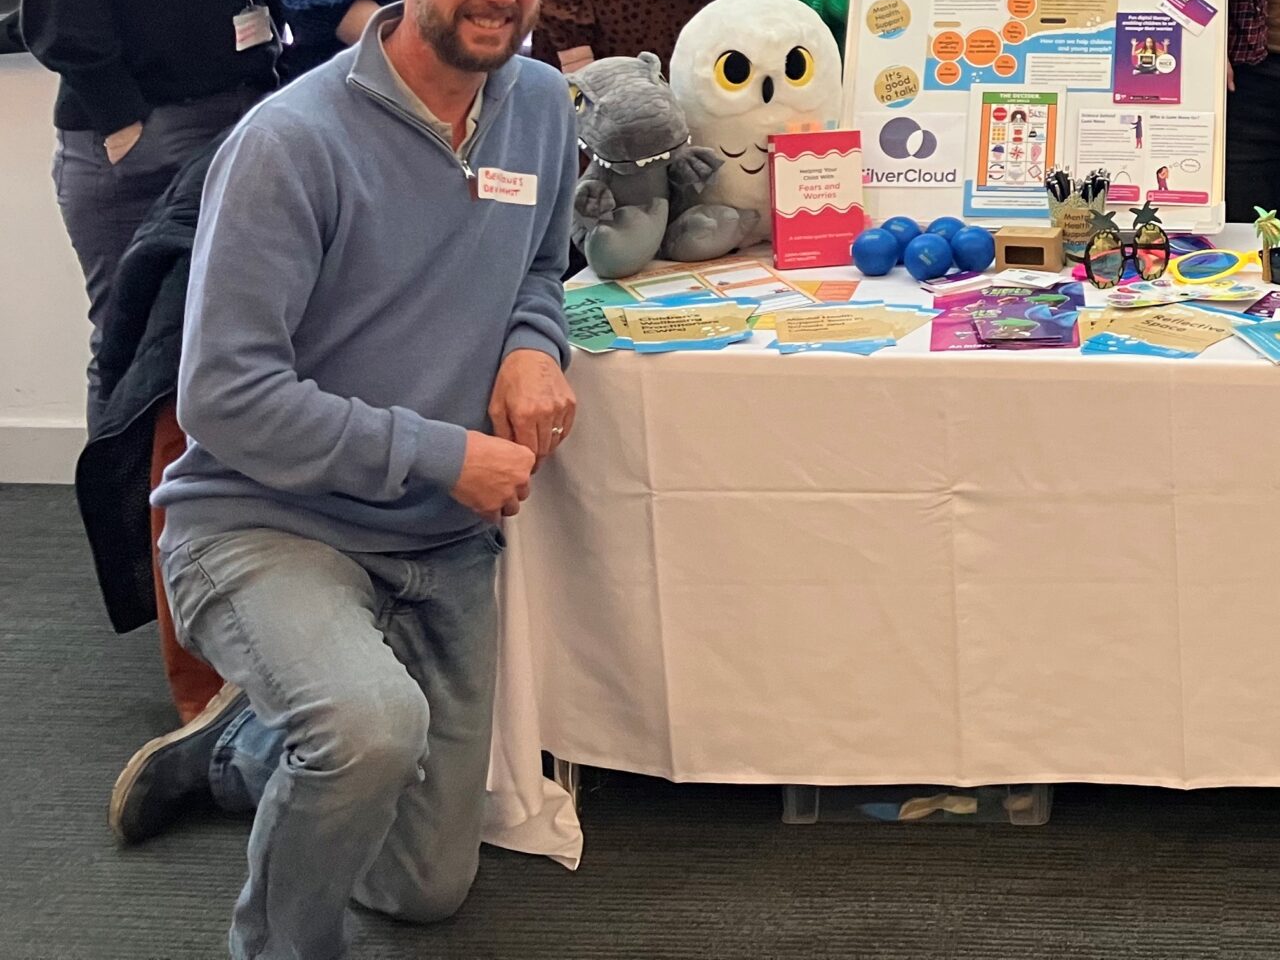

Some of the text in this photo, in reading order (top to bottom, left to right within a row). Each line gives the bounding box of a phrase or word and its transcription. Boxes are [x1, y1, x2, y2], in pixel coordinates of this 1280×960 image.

[885, 71, 902, 82] It's
[885, 76, 911, 93] good
[880, 85, 918, 102] to talk!
[803, 192, 837, 200] Worries
[1140, 320, 1186, 332] Space
[1153, 314, 1225, 333] Reflective
